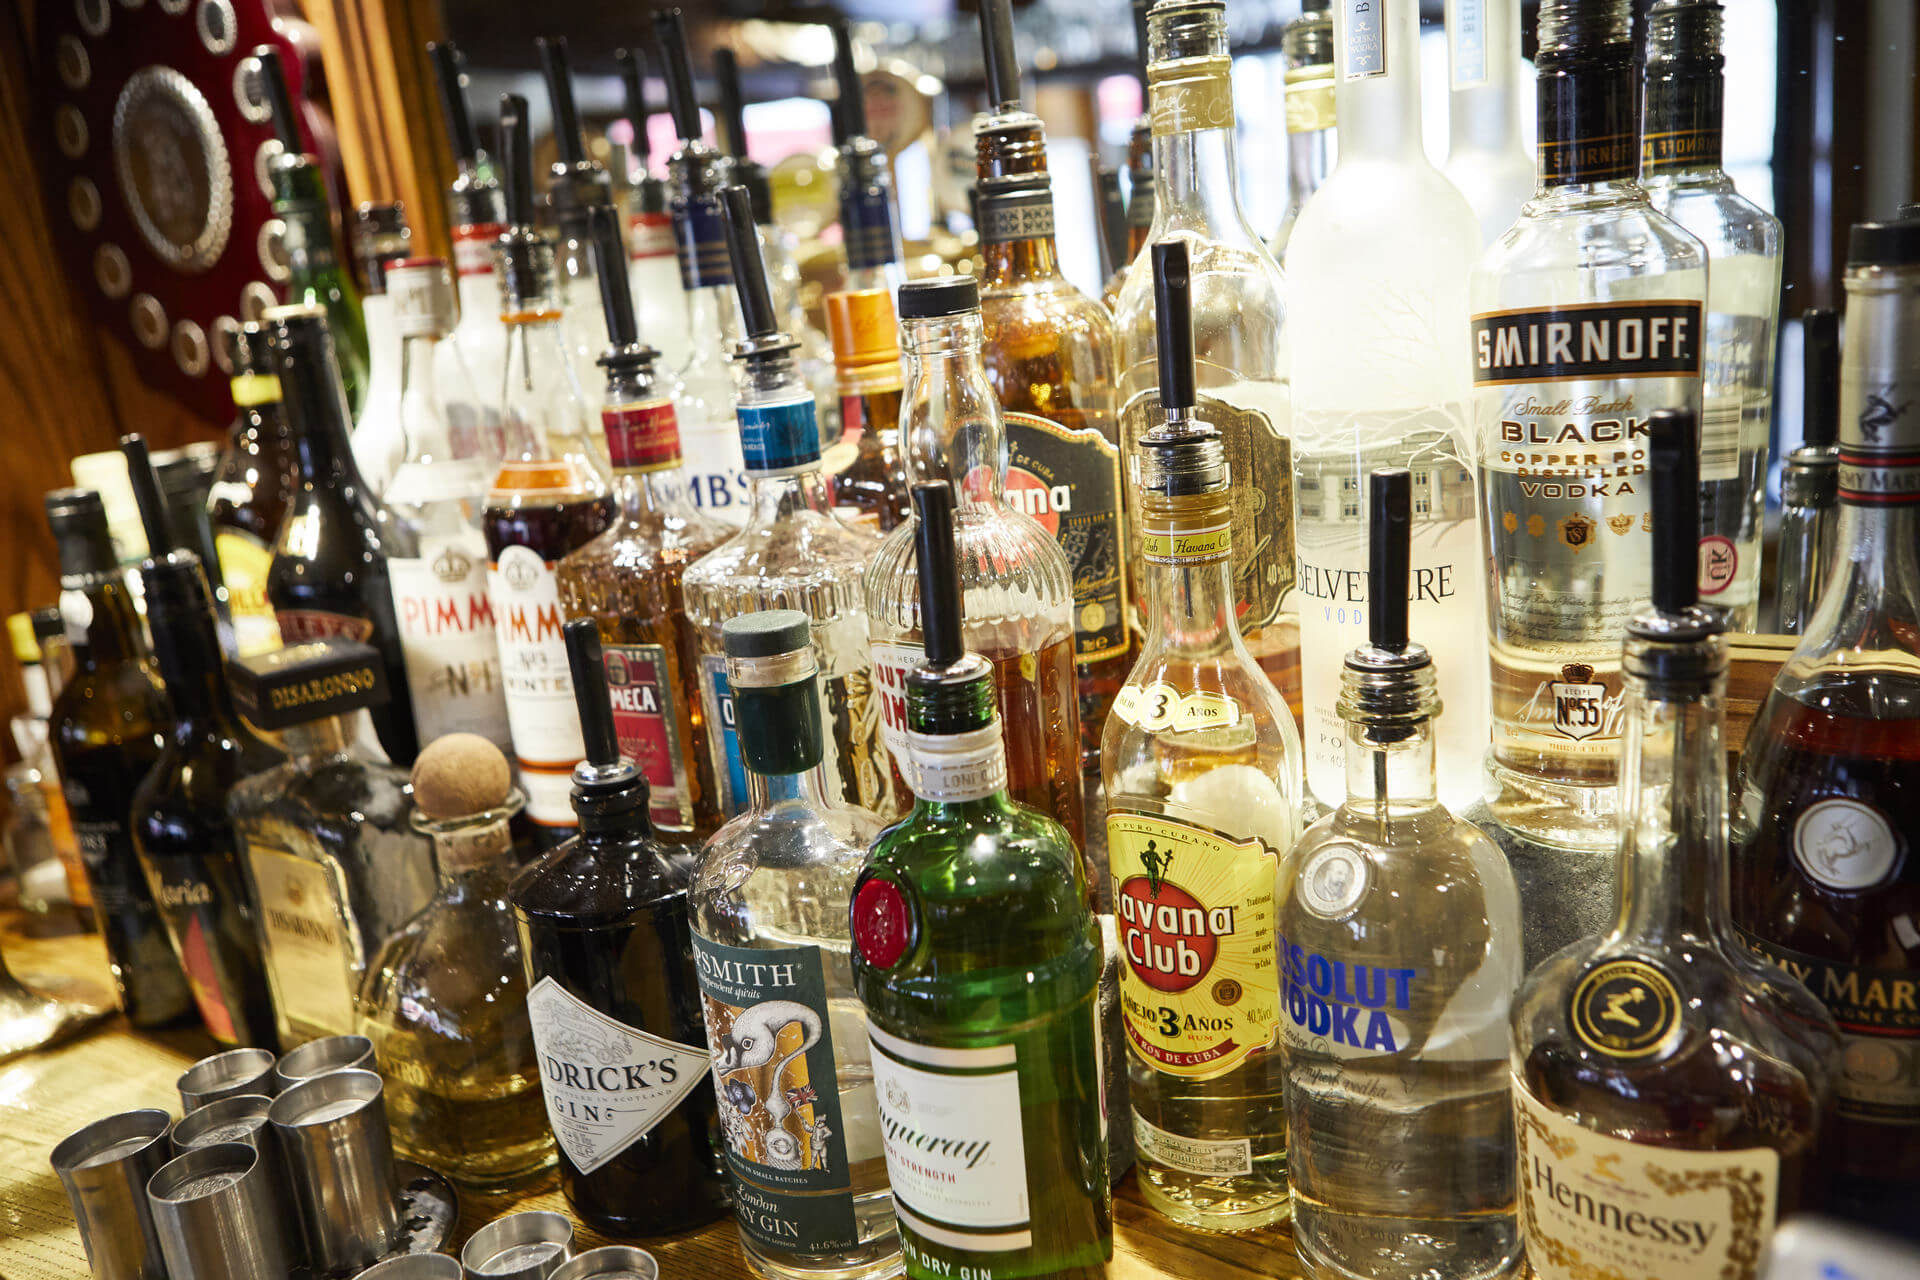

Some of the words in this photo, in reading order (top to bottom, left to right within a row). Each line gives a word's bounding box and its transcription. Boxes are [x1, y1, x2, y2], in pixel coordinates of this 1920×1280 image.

[1477, 317, 1687, 369] SMIRNOFF
[1514, 395, 1573, 416] Small
[1573, 394, 1634, 416] Batch
[1501, 417, 1650, 444] BLACK
[1501, 451, 1599, 466] COPPER
[1613, 449, 1645, 463] PO
[1517, 464, 1645, 479] DISTILLED
[1520, 481, 1636, 499] VODKA
[1173, 539, 1216, 554] Havana
[1297, 555, 1456, 604] BELVERE
[403, 591, 497, 635] PIMM
[1324, 606, 1363, 625] VOD
[271, 668, 375, 710] DISARONNO
[610, 686, 658, 713] MECA
[1151, 694, 1169, 719] 3
[1123, 823, 1153, 832] PURO
[1161, 829, 1221, 852] CUBANO
[1112, 873, 1235, 937] Havana
[694, 943, 797, 987] PSMITH
[1127, 928, 1201, 977] Club
[1278, 931, 1416, 1010] BSOLUT
[732, 986, 761, 1000] spirits
[1158, 1006, 1182, 1039] 3
[1183, 1013, 1234, 1032] AÑOS
[1187, 1034, 1214, 1042] RUM
[1141, 1041, 1161, 1059] RON
[1165, 1053, 1182, 1064] DE
[1186, 1048, 1221, 1064] CUBA
[546, 1054, 678, 1092] DRICK'S
[554, 1096, 601, 1122] GIN
[614, 1089, 673, 1104] SCOTLAND
[775, 1175, 808, 1184] BATCHES
[900, 1155, 958, 1185] STRENGTH
[736, 1183, 779, 1214] London
[1533, 1154, 1718, 1255] Hennessy
[759, 1214, 800, 1238] GIN
[921, 1251, 952, 1278] DRY
[960, 1266, 993, 1280] GIN
